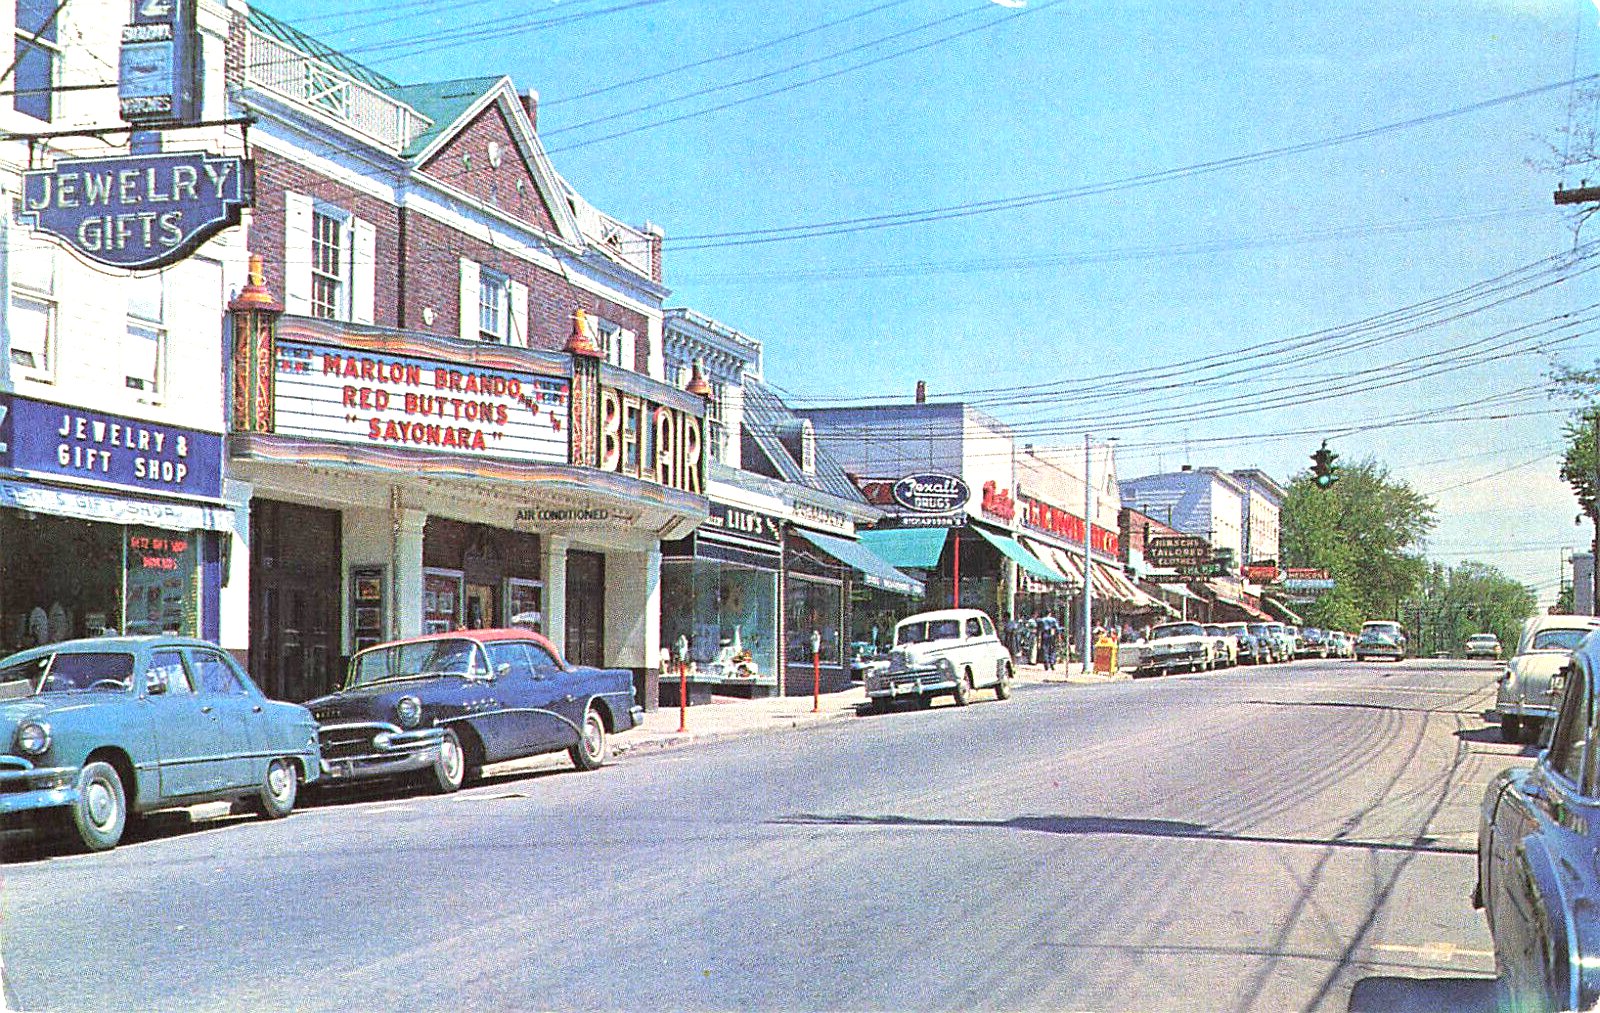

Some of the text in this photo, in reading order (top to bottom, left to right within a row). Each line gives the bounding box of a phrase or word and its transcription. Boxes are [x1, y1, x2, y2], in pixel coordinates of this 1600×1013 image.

[28, 163, 234, 211] JEWELRY
[77, 211, 183, 250] GIFTS
[322, 353, 421, 387] MARLON
[434, 369, 522, 399] BRANDO
[342, 385, 390, 411] RED
[405, 393, 508, 426] BUTTONS
[58, 414, 189, 457] JEWELRY &
[57, 444, 188, 484] GIFT SHOP
[904, 478, 959, 498] Rexall
[914, 498, 951, 510] DRUGS
[515, 508, 609, 521] AIR CONDITIONED
[1151, 548, 1205, 557] TAILORED
